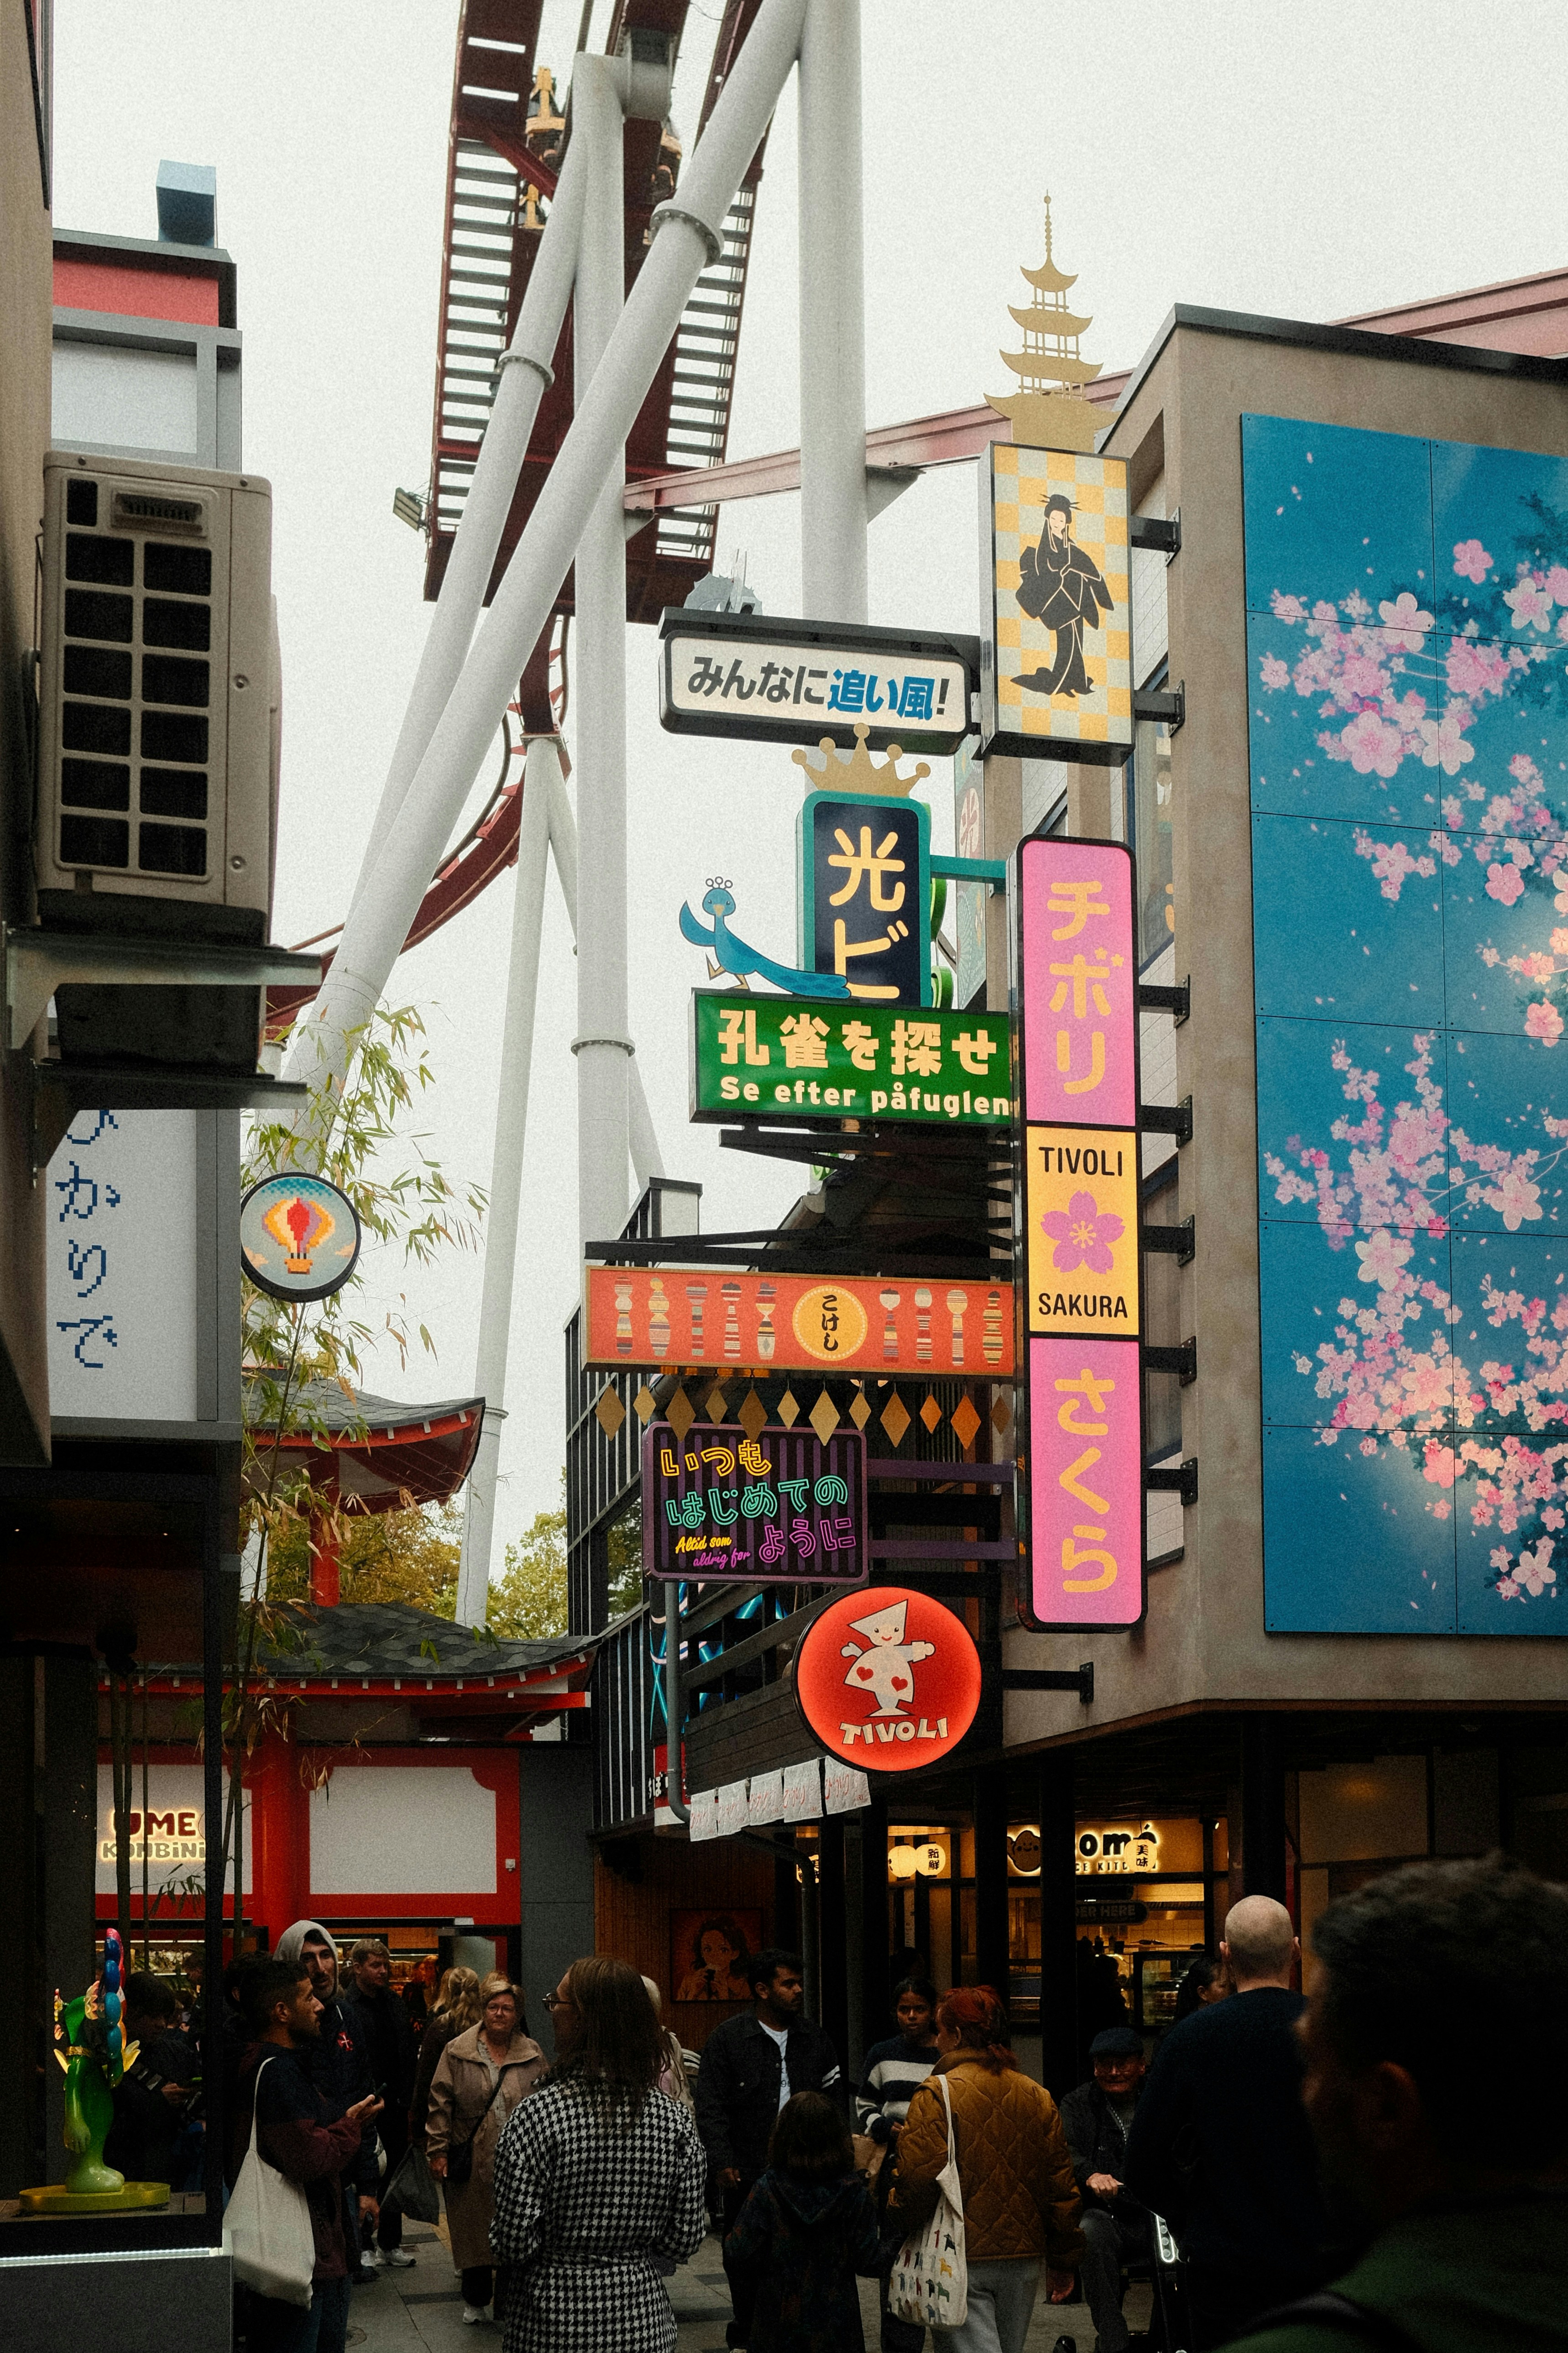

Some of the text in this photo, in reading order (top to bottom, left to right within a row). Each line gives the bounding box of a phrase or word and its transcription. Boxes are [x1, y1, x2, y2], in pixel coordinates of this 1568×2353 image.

[688, 657, 950, 721] みんなに追い風!
[1047, 881, 1124, 1094] チボリ
[719, 1009, 997, 1077] 孔雀を探せ
[721, 1076, 1009, 1117] Se efter påfuglen
[1039, 1147, 1122, 1176] TIVOLI
[821, 1294, 839, 1352] こけし
[1039, 1293, 1128, 1318] SAKURA
[660, 1439, 772, 1477] いつも
[1054, 1368, 1118, 1592] さくら
[665, 1475, 848, 1529] はじめての
[675, 1535, 732, 1554] Altid som
[758, 1517, 856, 1563] ように
[693, 1551, 729, 1570] aldrig
[840, 1717, 948, 1745] TIVOLI
[928, 1849, 940, 1870] 新鮮
[1136, 1845, 1149, 1867] 美味
[1100, 1904, 1136, 1917] HERE
